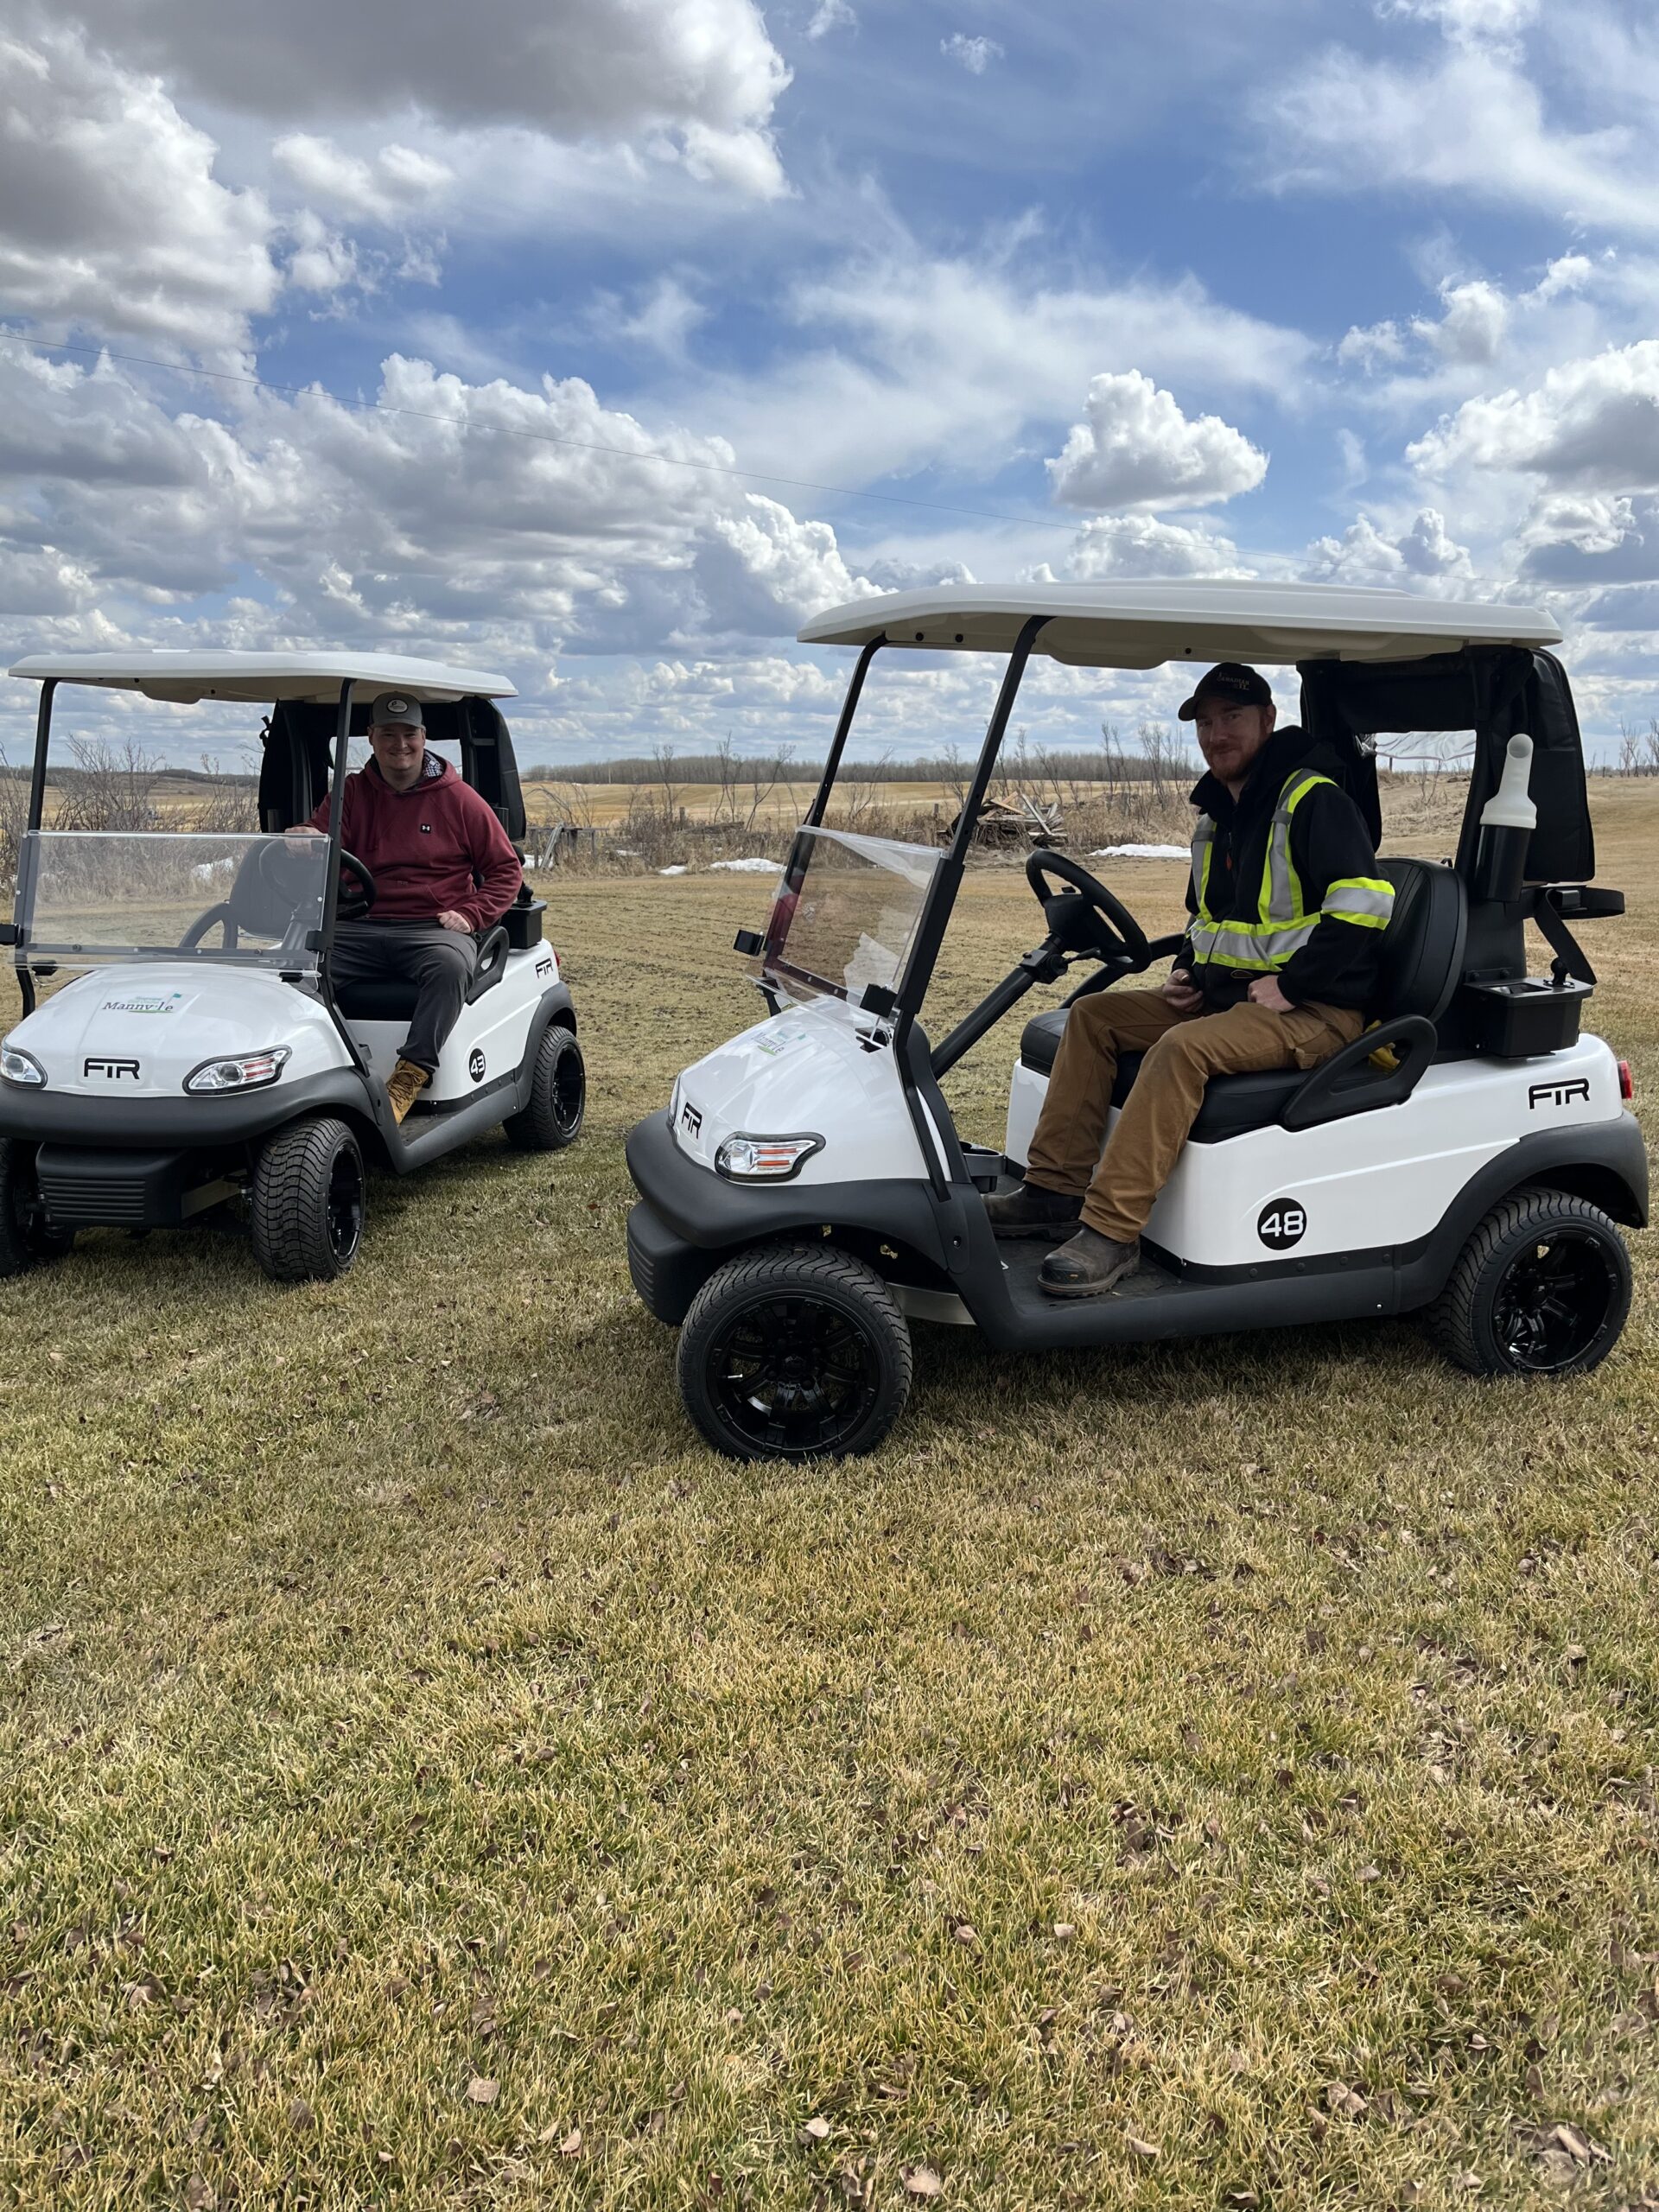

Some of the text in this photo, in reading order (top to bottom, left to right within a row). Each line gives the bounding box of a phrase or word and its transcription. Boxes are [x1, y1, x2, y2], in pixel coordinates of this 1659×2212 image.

[536, 957, 553, 979] FTR
[102, 1001, 174, 1011] Mannvle
[84, 1058, 140, 1079] FTR
[471, 1055, 485, 1074] 43
[1529, 1077, 1590, 1109] FTR
[1261, 1210, 1303, 1236] 48
